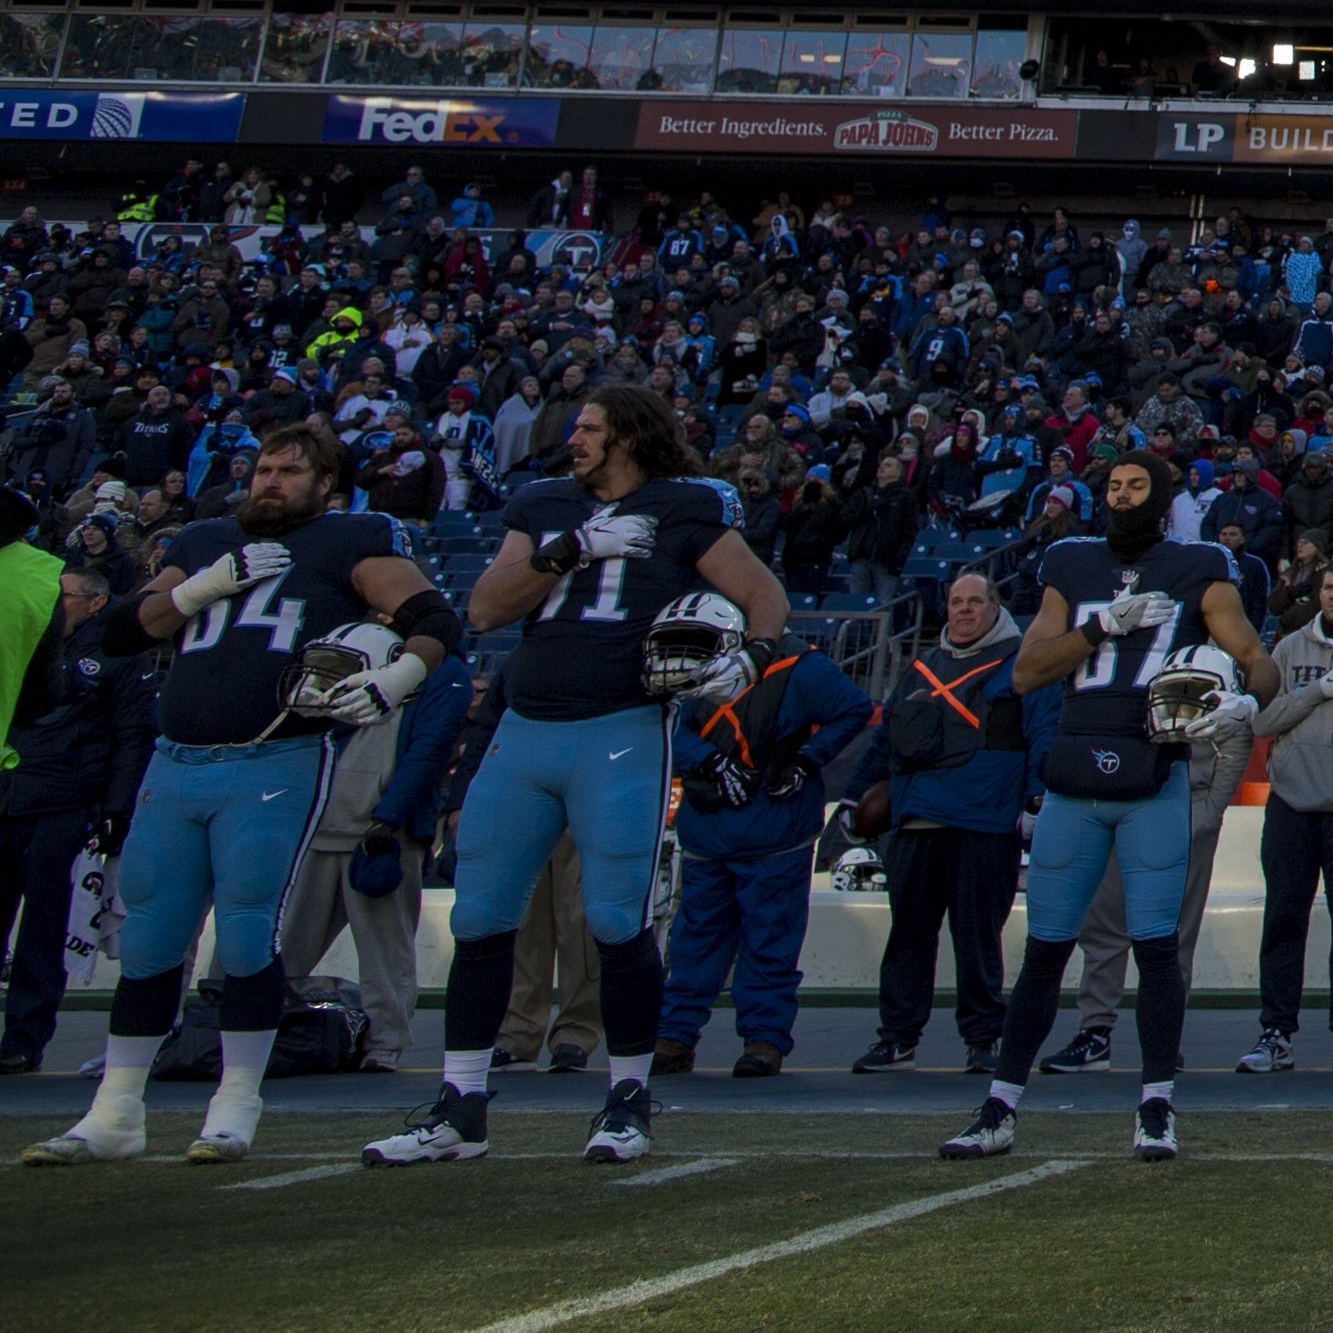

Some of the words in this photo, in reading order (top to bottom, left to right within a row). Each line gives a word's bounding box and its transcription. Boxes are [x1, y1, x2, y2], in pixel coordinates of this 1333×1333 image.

[0, 102, 79, 128] ED
[659, 115, 715, 135] Better
[719, 116, 827, 139] Ingredients.
[838, 123, 880, 146] PAPA
[881, 123, 933, 147] JOHNS
[948, 122, 1004, 141] Better
[1008, 123, 1059, 142] Pizza.
[1173, 122, 1224, 153] LP
[670, 239, 690, 256] 87
[134, 422, 169, 435] TITANS
